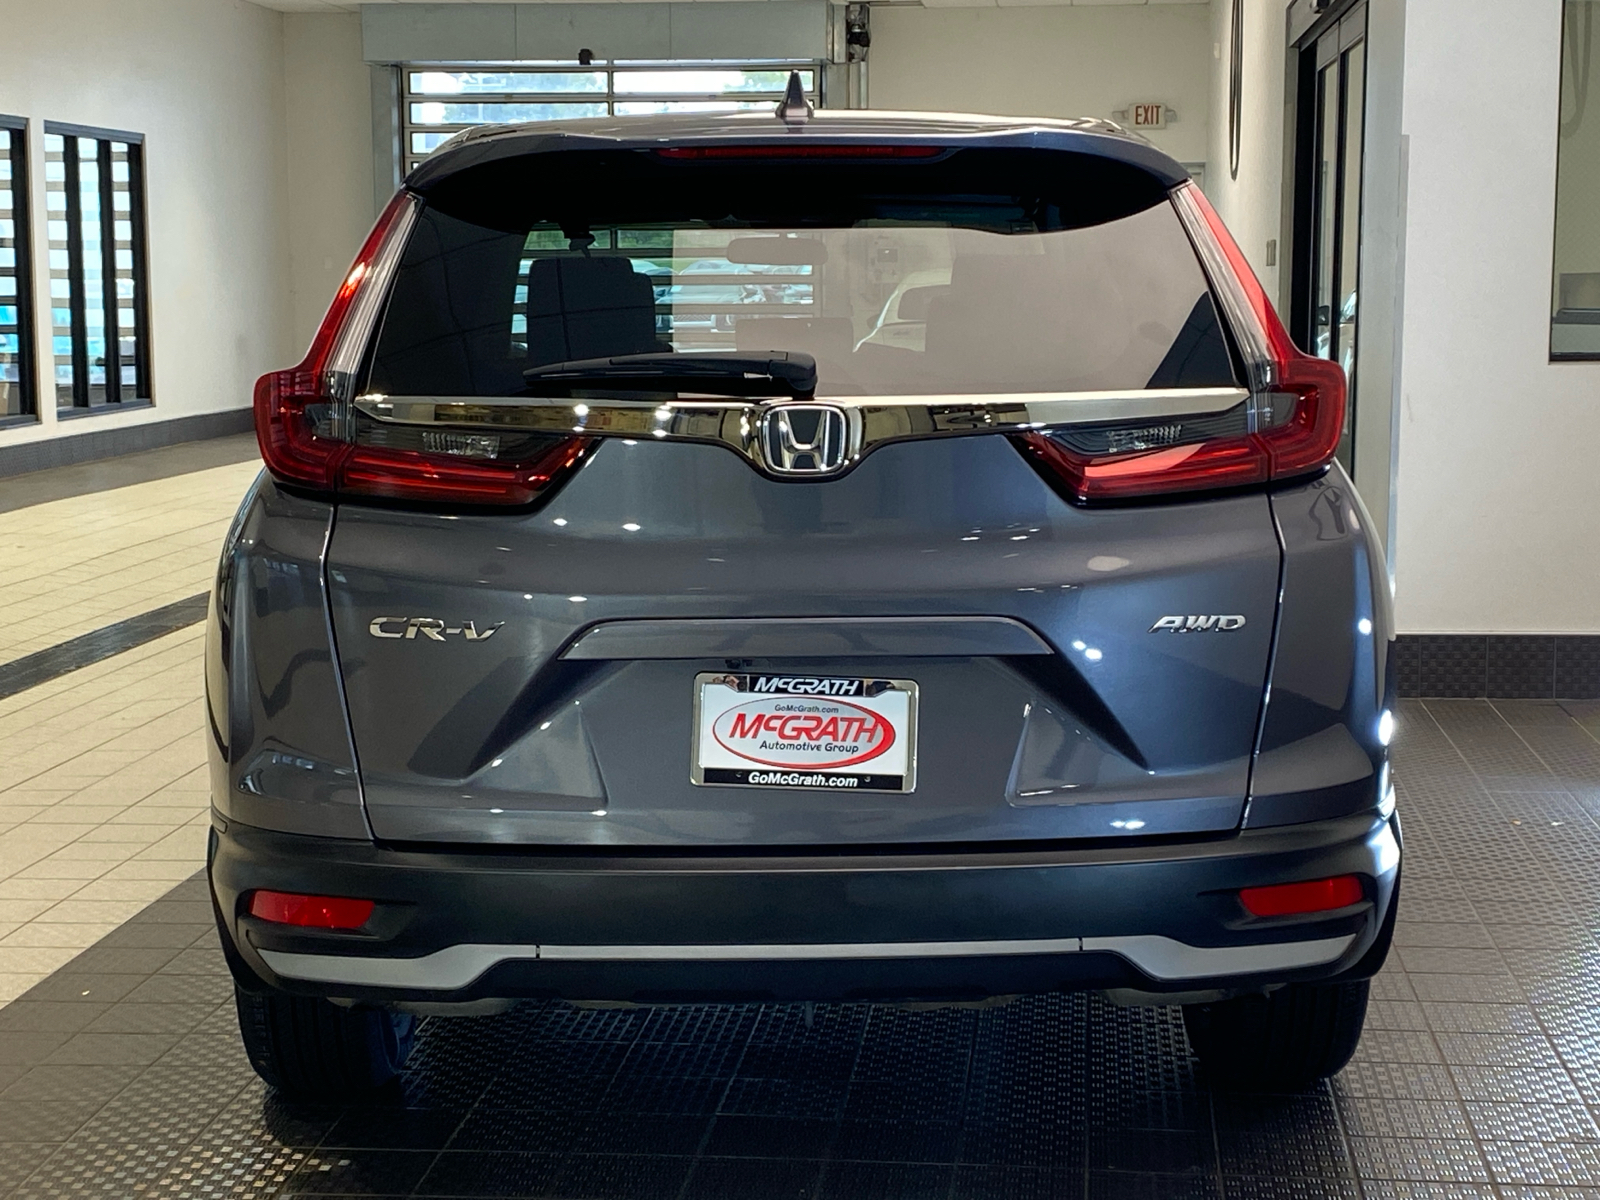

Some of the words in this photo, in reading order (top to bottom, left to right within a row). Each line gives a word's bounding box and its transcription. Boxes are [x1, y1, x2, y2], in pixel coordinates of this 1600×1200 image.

[1135, 105, 1161, 125] EXIT
[369, 616, 505, 642] CR-V
[1148, 614, 1246, 633] AWD
[774, 704, 839, 714] GoMcGrath.com
[759, 740, 822, 752] Automotive
[825, 742, 859, 754] Group
[748, 772, 858, 788] GoMcGrath.com
